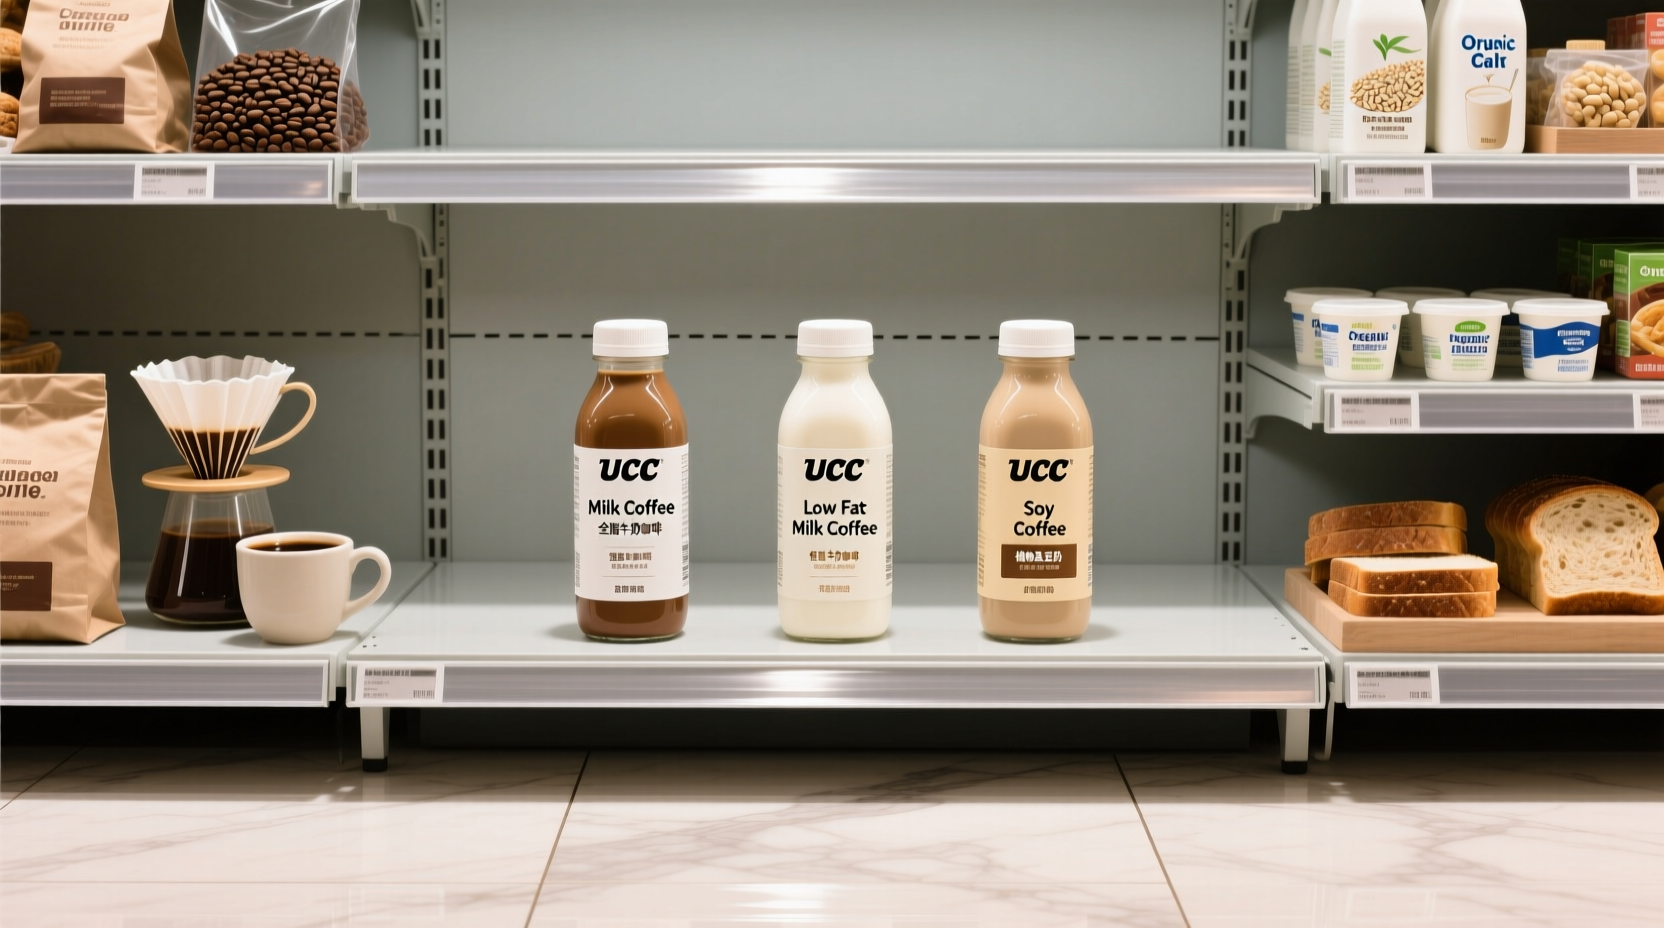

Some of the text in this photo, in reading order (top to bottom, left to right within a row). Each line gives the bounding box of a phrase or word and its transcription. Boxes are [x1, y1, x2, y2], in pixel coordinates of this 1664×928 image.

[600, 459, 660, 481] UCC
[805, 459, 864, 481] UCC
[1009, 459, 1068, 482] UCC
[589, 499, 674, 515] Milk Coffee
[805, 500, 867, 514] Low Fat
[1024, 501, 1054, 519] Soy
[793, 520, 877, 536] Milk Coffee
[1014, 520, 1066, 536] Coffee
